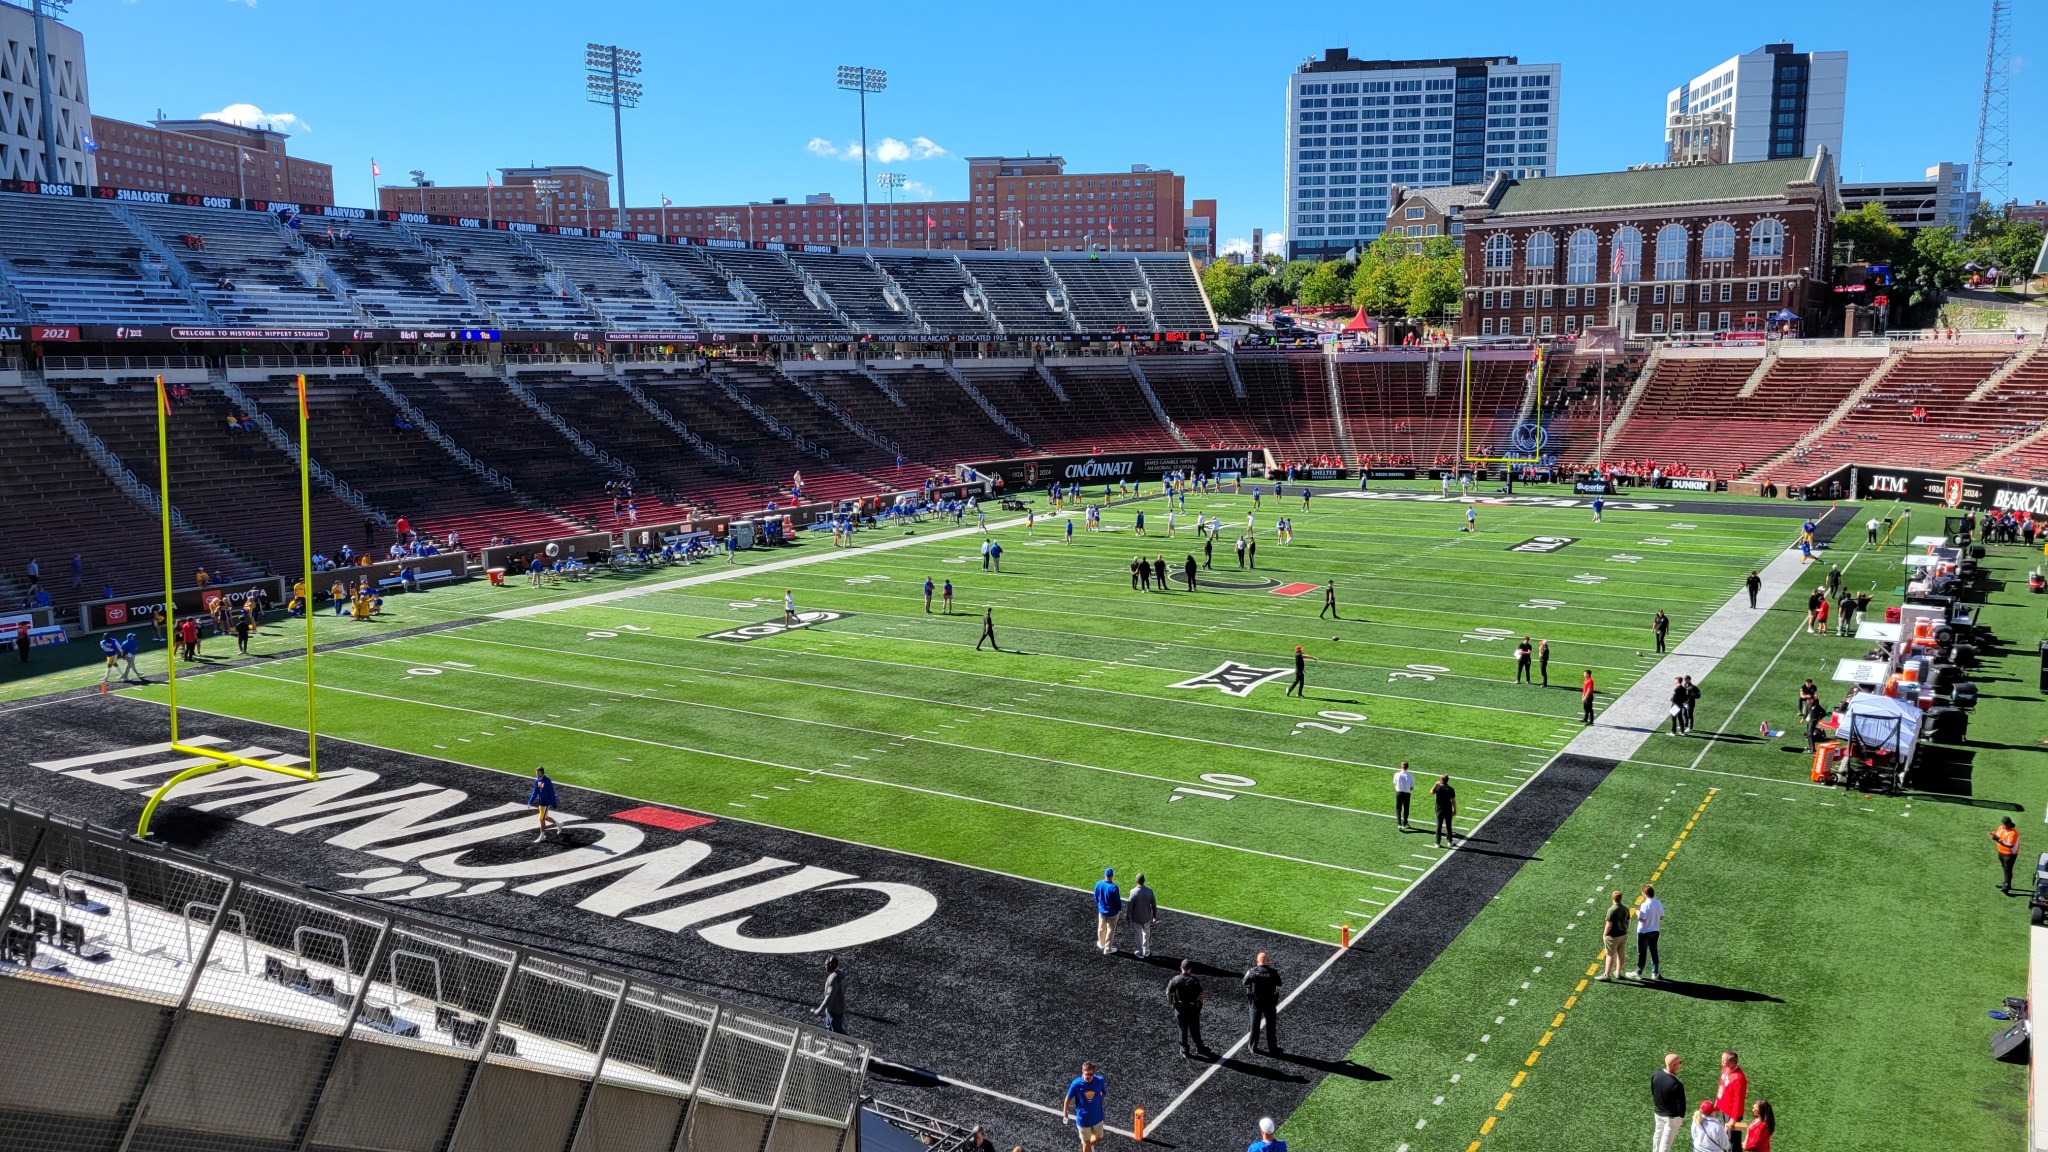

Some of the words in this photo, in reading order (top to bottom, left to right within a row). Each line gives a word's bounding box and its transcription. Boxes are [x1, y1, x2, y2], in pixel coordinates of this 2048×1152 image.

[21, 182, 37, 193] 28
[40, 184, 73, 196] ROSSI
[100, 188, 114, 199] 29
[117, 189, 170, 204] SHALOSKY
[186, 196, 200, 206] 62
[203, 197, 232, 208] GOIST
[254, 201, 266, 211] 10
[268, 202, 300, 214] OWENS
[315, 207, 321, 215] 5
[324, 206, 366, 219] MARVASO
[386, 212, 398, 222] 30
[400, 213, 429, 224] WOODS
[460, 218, 480, 228] COOK
[508, 222, 537, 233] O'BRIEN
[559, 226, 583, 236] TAYLOR
[637, 233, 658, 243] RUFFIN
[678, 237, 688, 245] LEE
[707, 239, 746, 249] WASHINGTON
[42, 329, 70, 339] 2021
[400, 331, 418, 339] 86:41
[1064, 461, 1134, 478] CINCINNATI
[1576, 482, 1606, 492] Superior
[1672, 480, 1709, 491] DUNKIN'
[1928, 484, 1944, 494] 1924
[1963, 488, 1979, 498] 2024
[225, 588, 268, 602] TOYOA
[585, 624, 652, 639] 20
[707, 621, 812, 640] TQL
[1462, 627, 1516, 643] 40
[1390, 663, 1451, 682] 30
[1297, 710, 1368, 735] 20
[1172, 773, 1257, 801] 10
[29, 734, 939, 954] CINCINNATI
